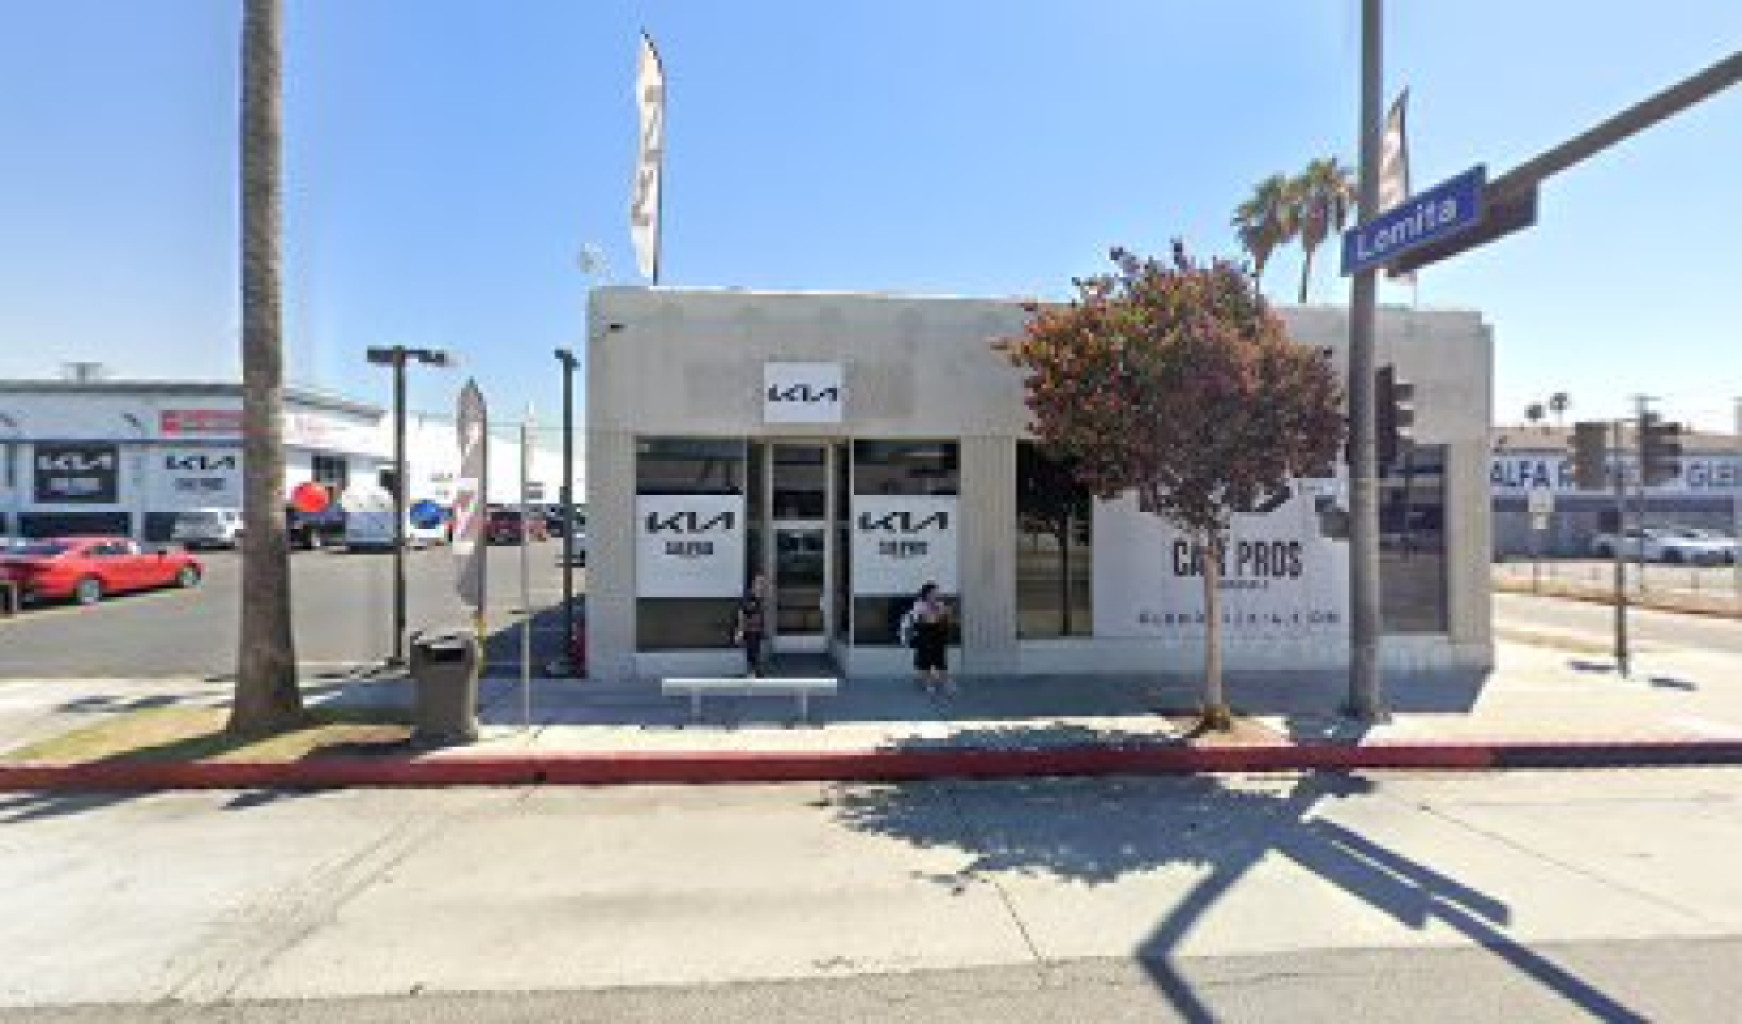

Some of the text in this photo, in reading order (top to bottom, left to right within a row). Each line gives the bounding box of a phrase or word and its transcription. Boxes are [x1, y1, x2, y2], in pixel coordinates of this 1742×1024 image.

[1357, 199, 1457, 260] Lomita
[768, 383, 838, 402] KIA
[1490, 460, 1550, 487] ALFA
[1686, 463, 1742, 487] GLE
[645, 511, 736, 534] KIA
[859, 511, 949, 534] KIA
[1235, 541, 1303, 579] PROS
